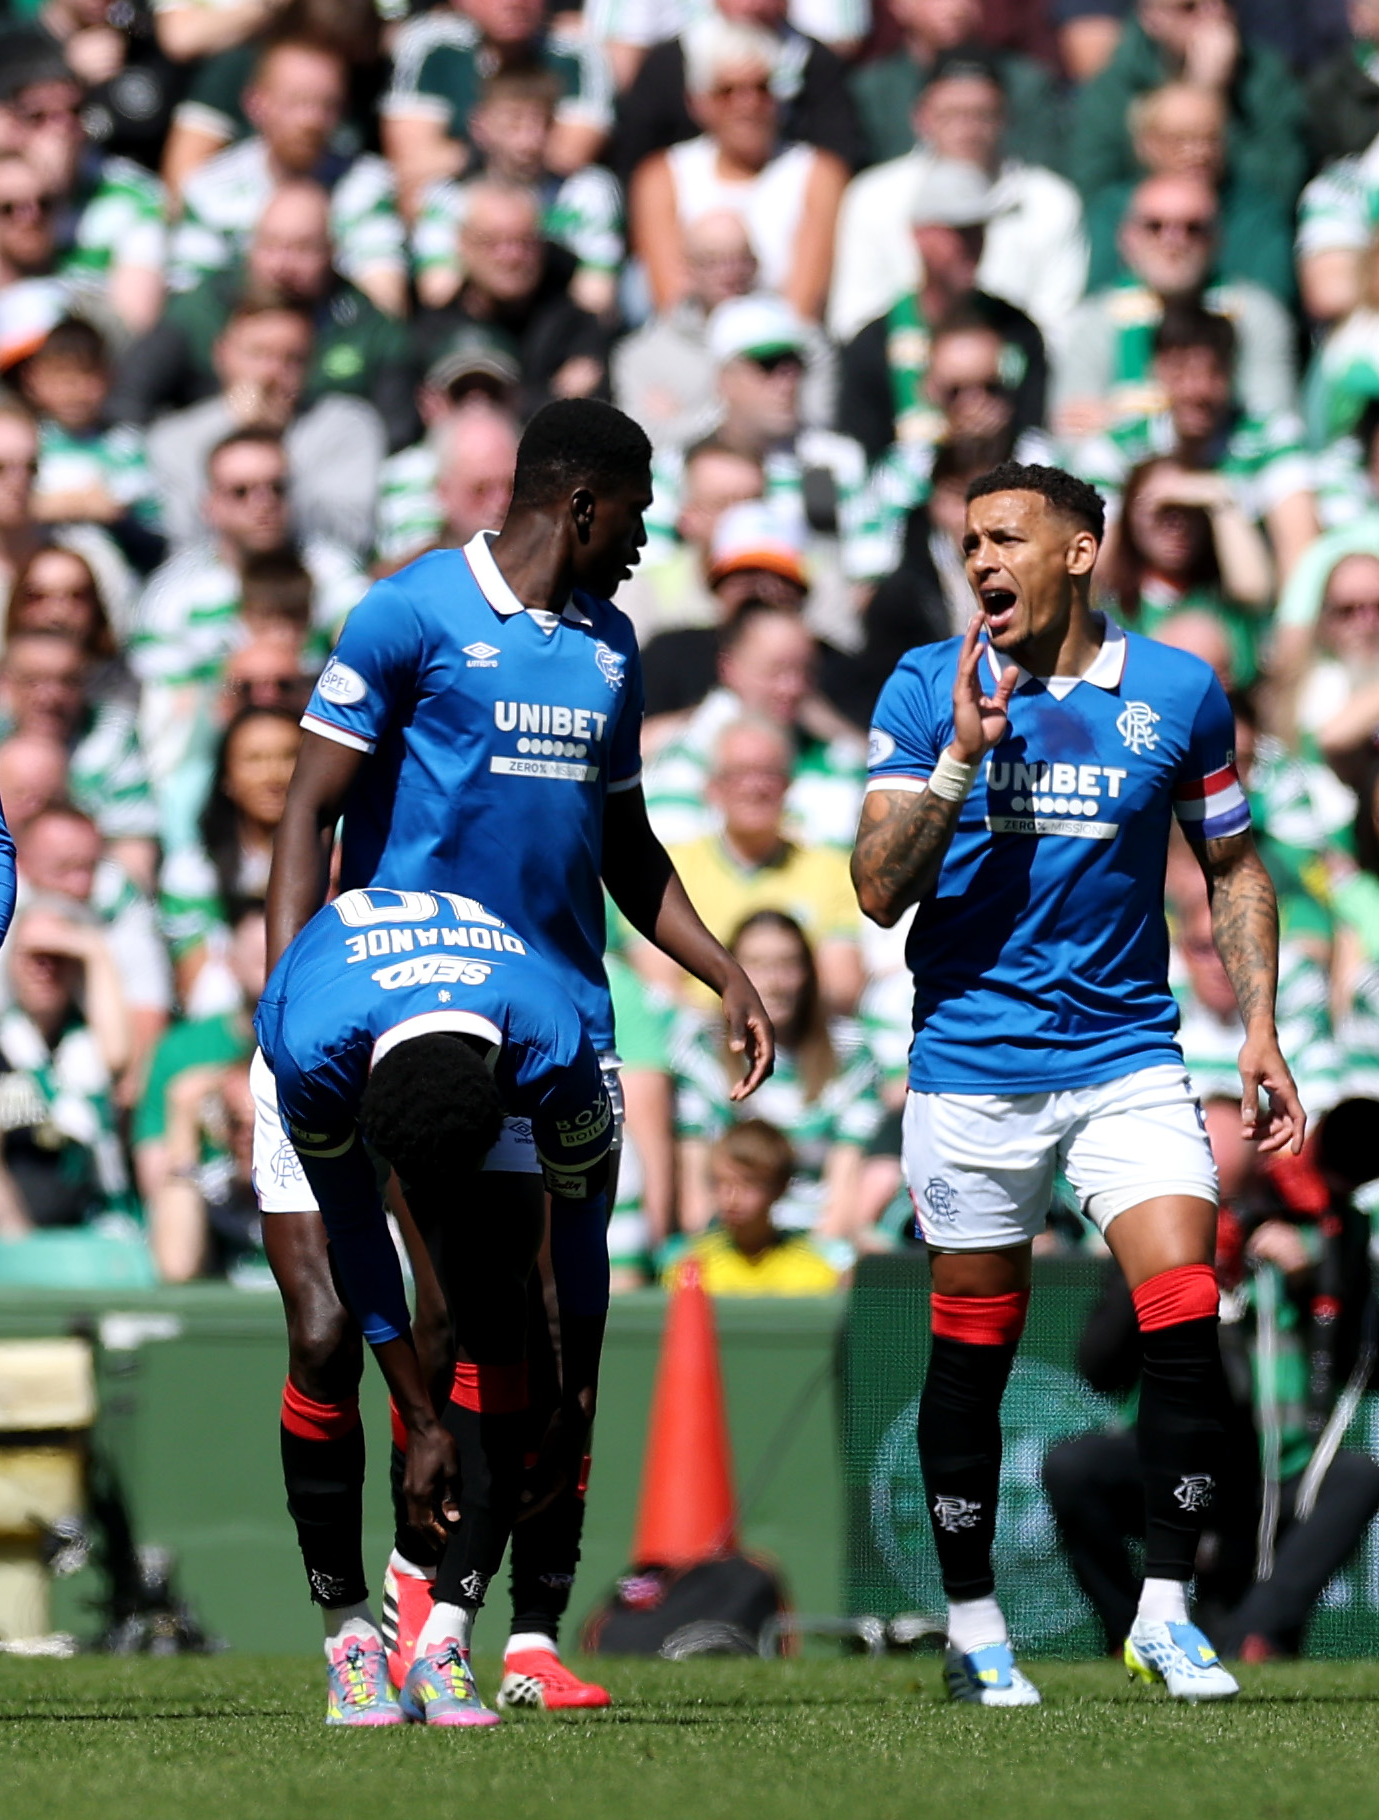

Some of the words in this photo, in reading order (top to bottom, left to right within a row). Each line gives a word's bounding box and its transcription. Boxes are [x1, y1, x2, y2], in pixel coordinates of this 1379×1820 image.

[466, 659, 498, 668] umbro
[493, 700, 608, 743] UNIBET
[509, 761, 547, 774] ZERO%
[985, 761, 1128, 799] UNIBET
[1003, 819, 1047, 832] ZERO%
[1050, 821, 1103, 836] MISSION
[345, 927, 527, 964] DIOMANDE
[555, 1090, 606, 1132] BOX
